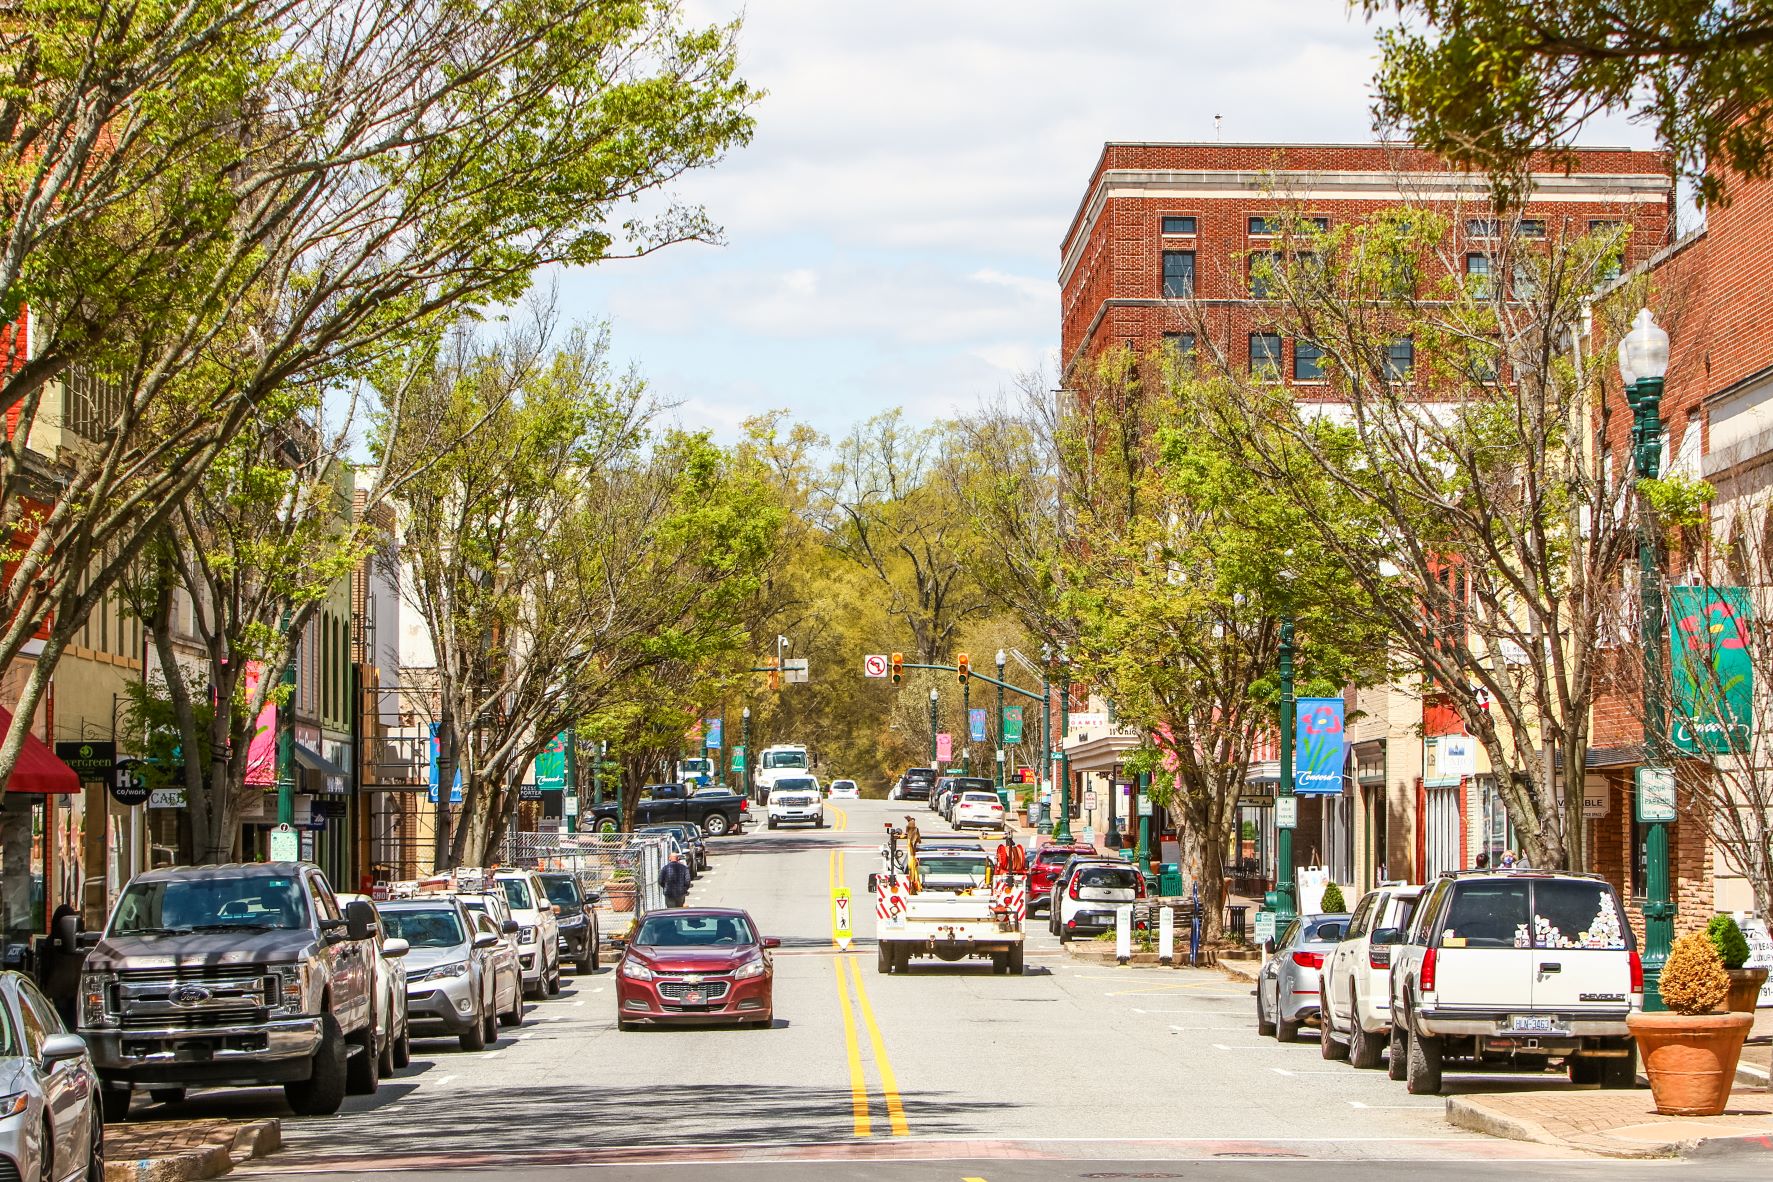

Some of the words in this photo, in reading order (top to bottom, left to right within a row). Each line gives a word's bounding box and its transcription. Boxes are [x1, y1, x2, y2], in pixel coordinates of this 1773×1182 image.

[64, 757, 112, 767] vergreen
[1296, 770, 1342, 786] Concord
[116, 788, 146, 796] co/work
[180, 991, 201, 1001] Ford
[1579, 993, 1626, 1001] CHEVROLET
